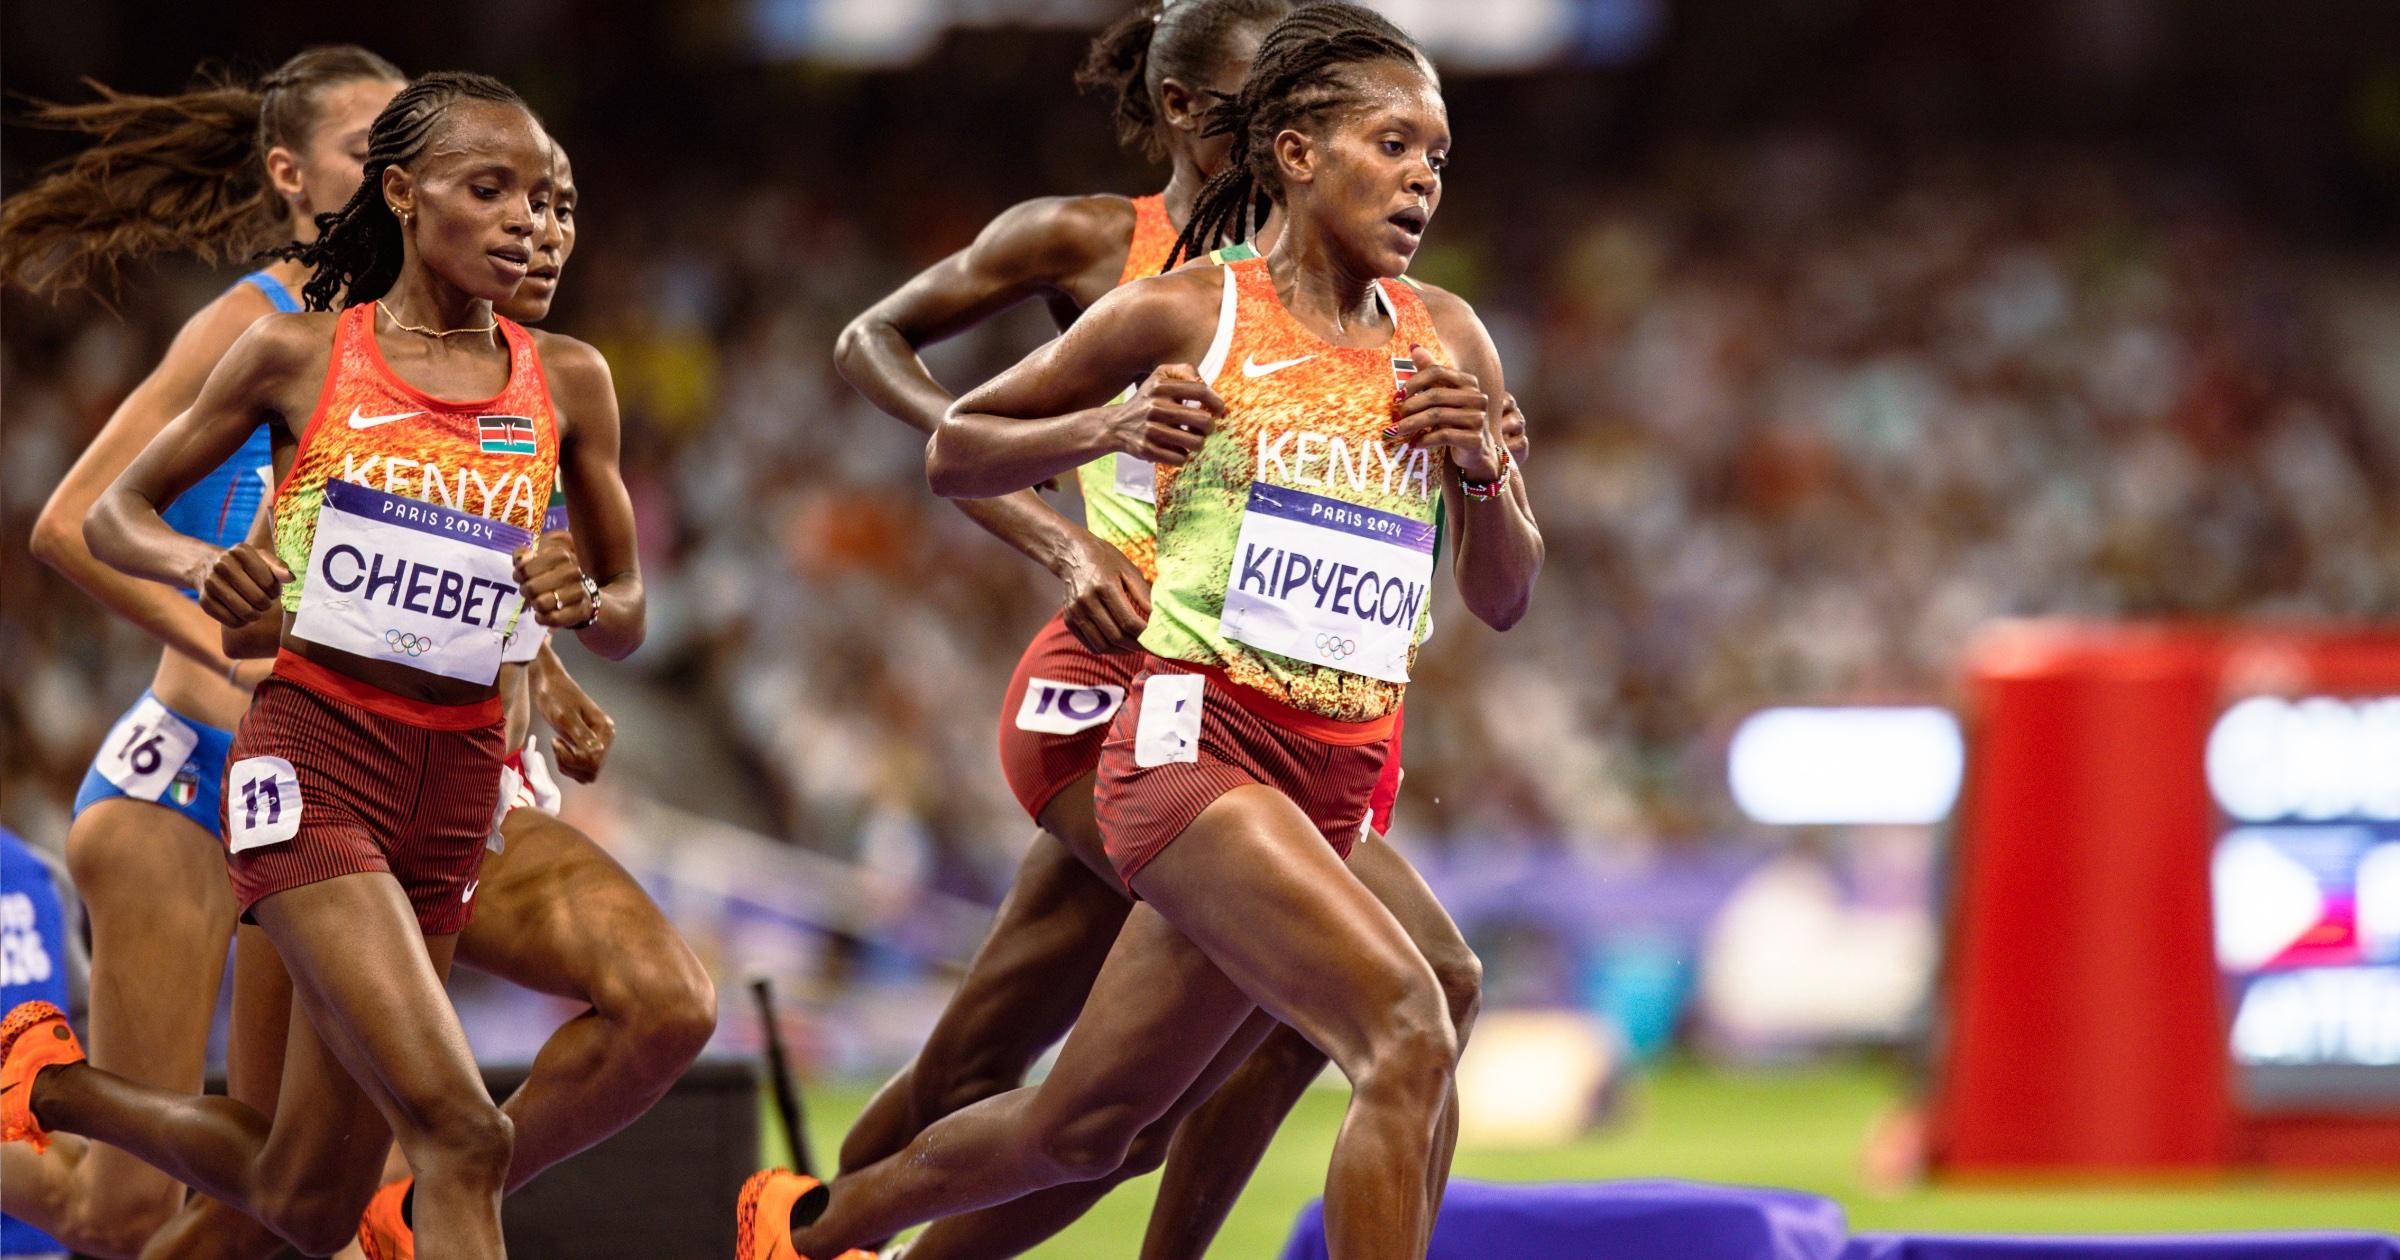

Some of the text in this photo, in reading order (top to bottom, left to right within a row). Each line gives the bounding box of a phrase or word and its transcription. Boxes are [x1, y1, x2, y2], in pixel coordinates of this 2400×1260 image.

[1257, 430, 1430, 501] KENYA
[382, 501, 494, 540] PARIS 2024
[1311, 502, 1402, 538] PARIS 2024
[321, 543, 521, 629] CHEBET
[1238, 542, 1425, 631] KIPYEGON
[1035, 686, 1112, 721] 10
[117, 724, 166, 776] 16
[241, 773, 282, 830] 11
